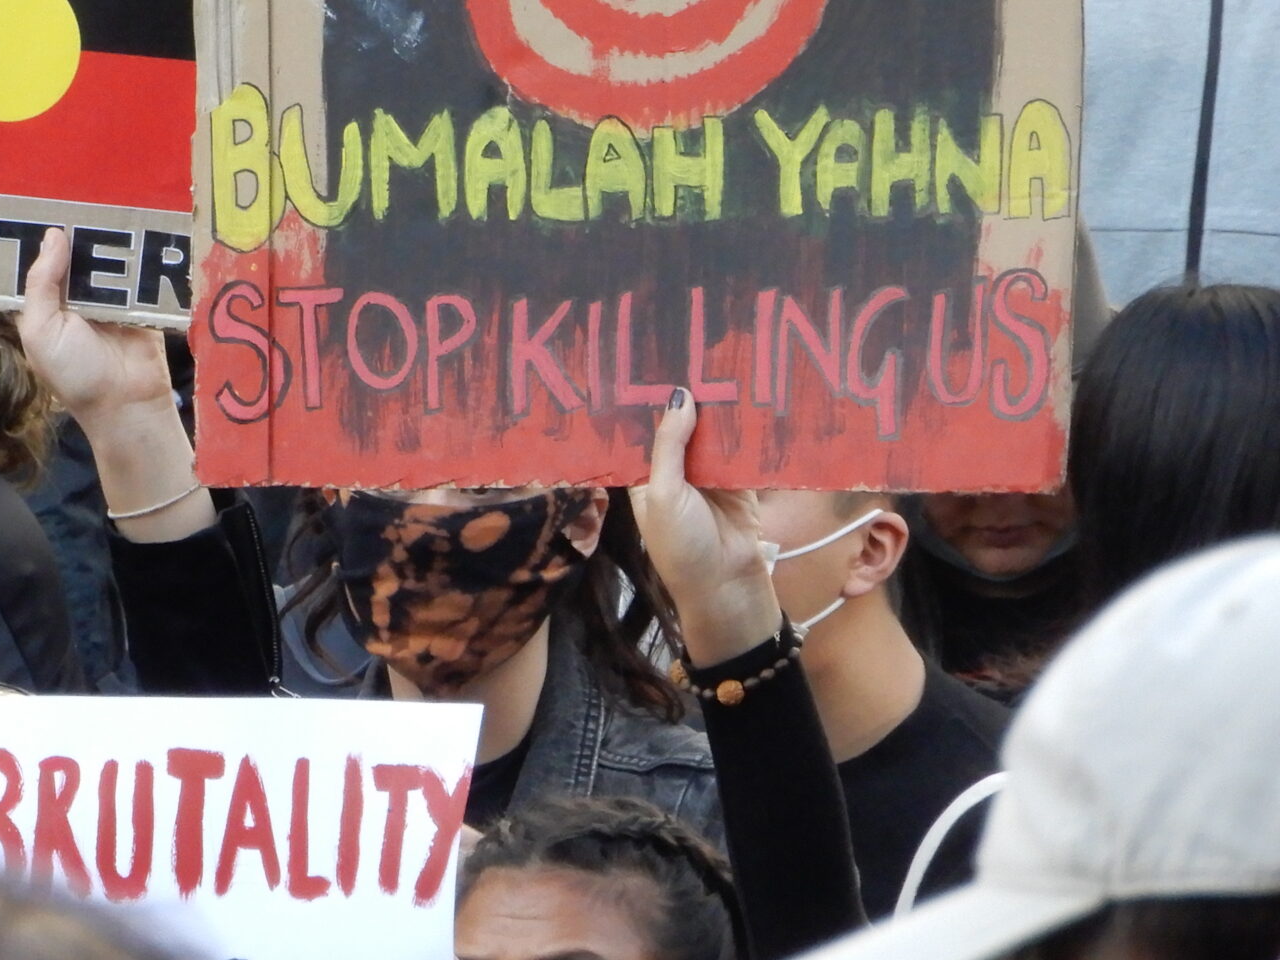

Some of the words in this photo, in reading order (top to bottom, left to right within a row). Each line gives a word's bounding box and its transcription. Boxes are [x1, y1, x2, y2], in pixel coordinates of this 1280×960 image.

[209, 82, 727, 252] BUMALAH
[755, 98, 1073, 221] YAHNA
[208, 281, 477, 424] STOP
[510, 283, 913, 441] KILLING
[927, 268, 1055, 420] US
